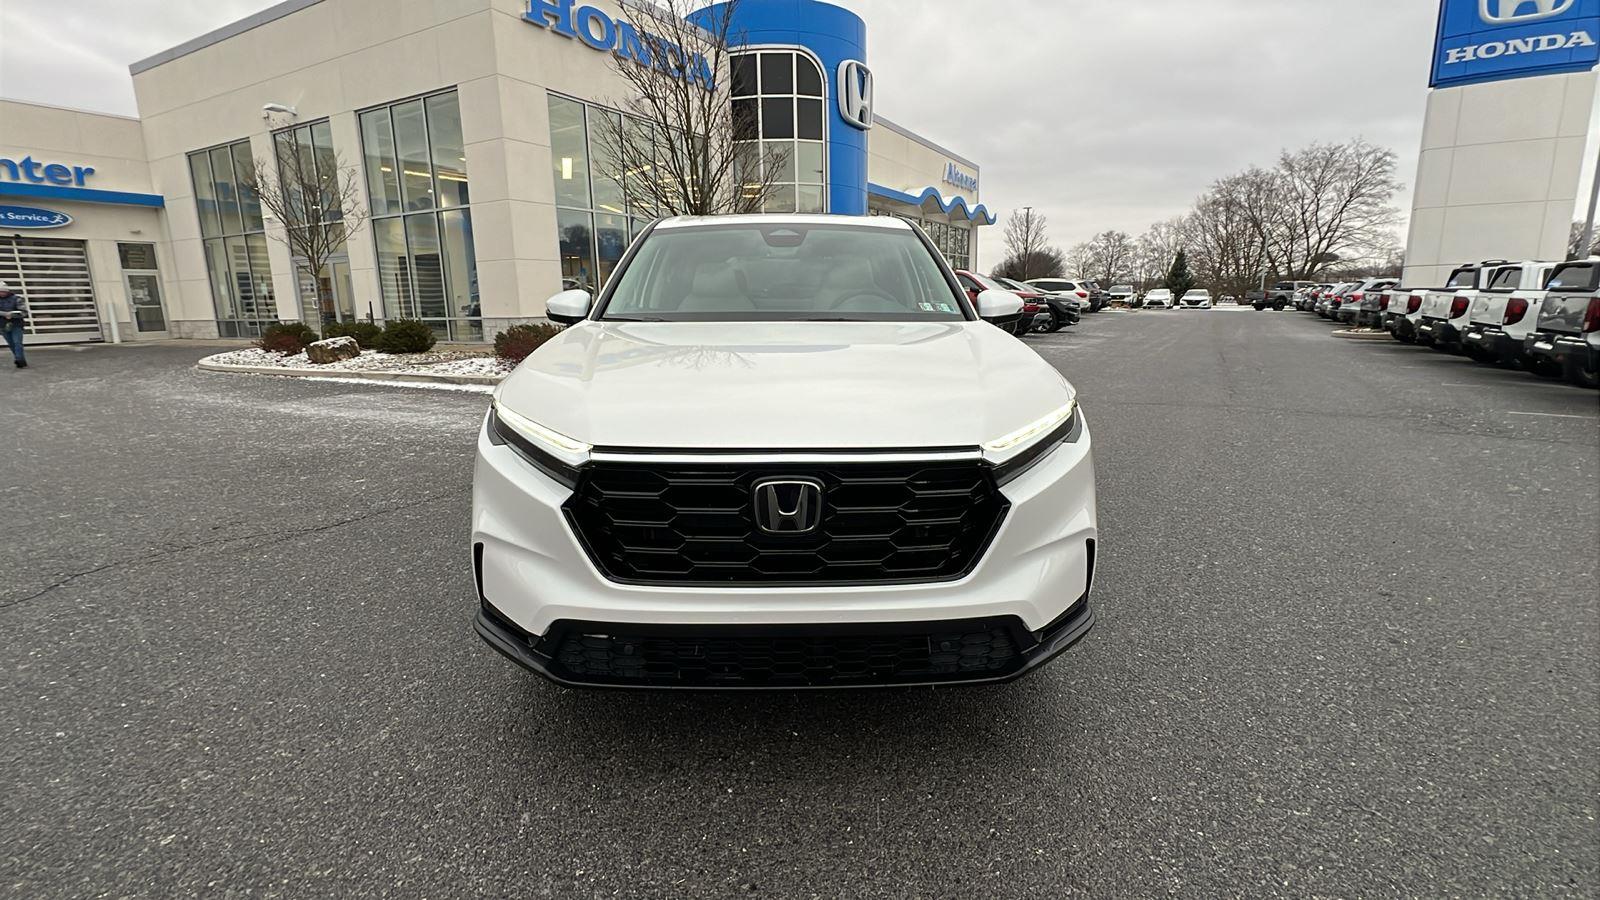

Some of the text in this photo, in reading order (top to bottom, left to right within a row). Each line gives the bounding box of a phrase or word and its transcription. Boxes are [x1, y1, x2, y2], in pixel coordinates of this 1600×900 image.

[521, 0, 718, 92] HONDA
[1444, 31, 1596, 64] HONDA
[7, 212, 49, 222] Service
